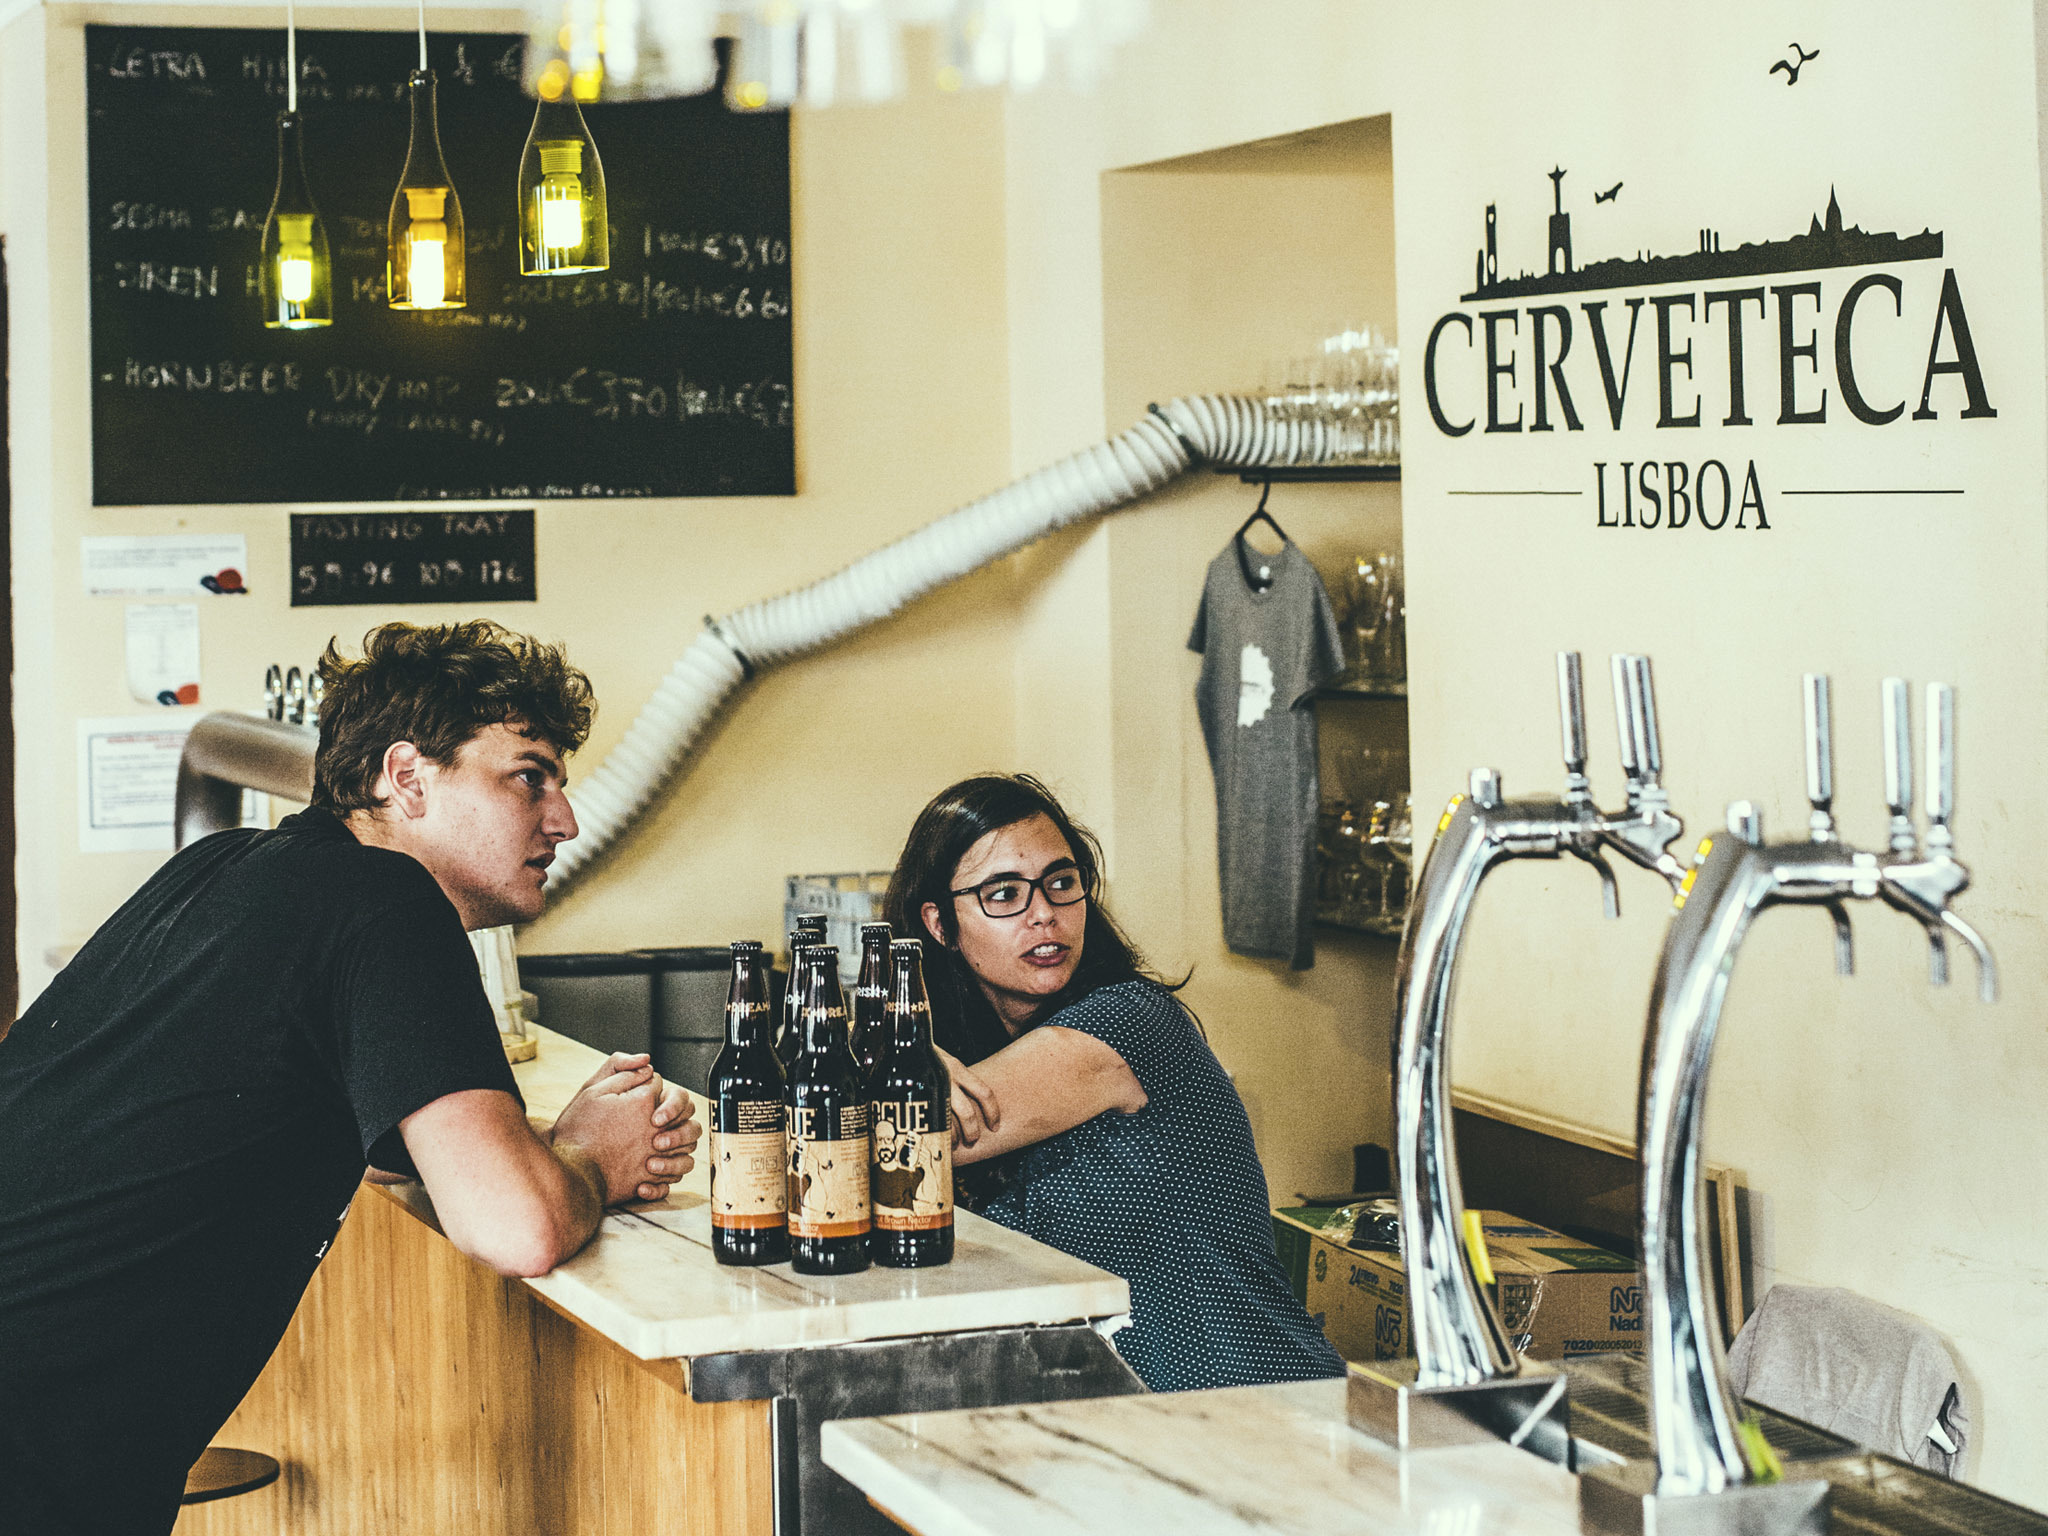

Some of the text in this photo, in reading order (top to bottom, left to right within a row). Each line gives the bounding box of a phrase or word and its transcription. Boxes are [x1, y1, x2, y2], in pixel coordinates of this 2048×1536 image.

[1423, 268, 1998, 438] CERVETECA
[296, 513, 509, 540] TASTING TRAY
[1594, 459, 1771, 531] LISBOA
